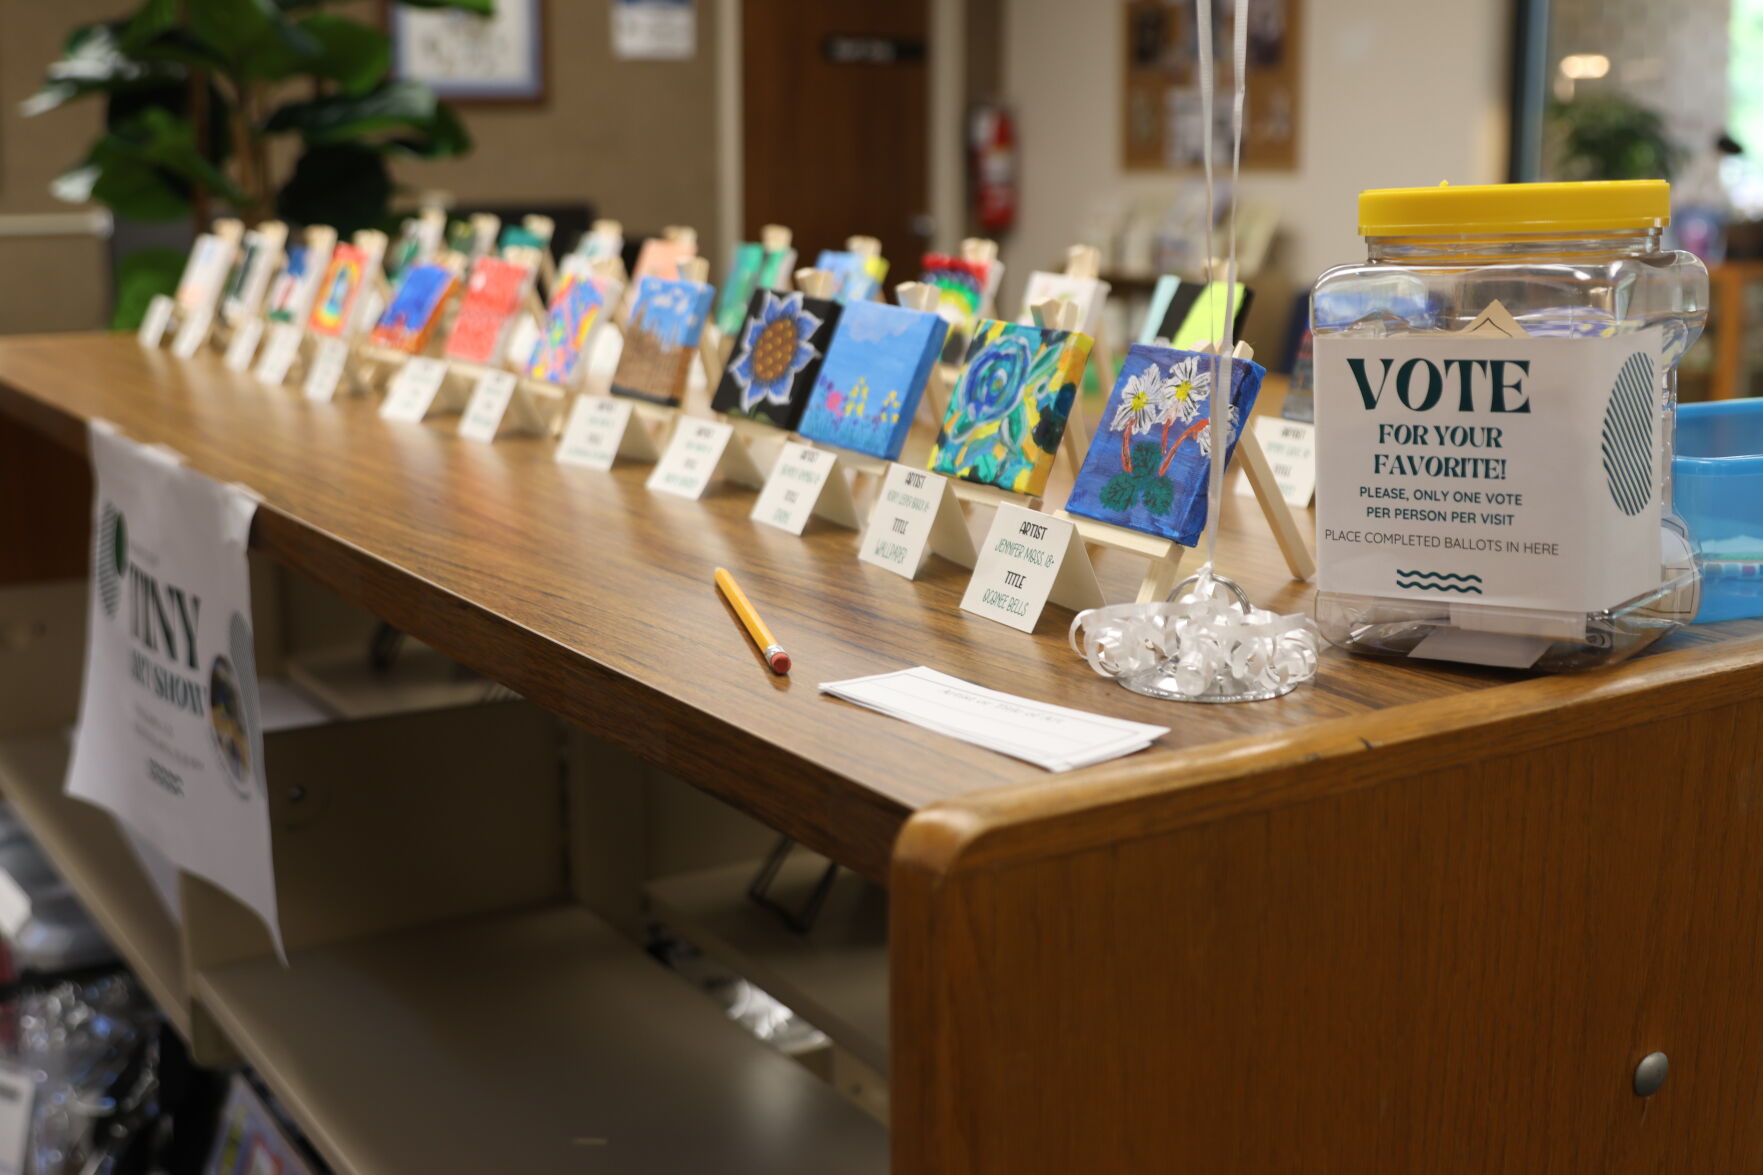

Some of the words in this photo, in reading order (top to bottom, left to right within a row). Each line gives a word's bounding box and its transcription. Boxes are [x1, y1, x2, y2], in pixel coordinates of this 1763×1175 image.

[1346, 357, 1531, 414] VOTE
[1378, 423, 1429, 446] FOR
[1433, 425, 1503, 448] YOUR
[1374, 453, 1507, 480] FAVORITE!
[1359, 486, 1409, 502] PLEASE,
[1413, 488, 1449, 502] ONLY
[1453, 491, 1481, 504] ONE
[1485, 493, 1523, 506] VOTE
[1366, 506, 1391, 519] PER
[1394, 508, 1447, 522] PERSON
[1451, 511, 1477, 524] PER
[1480, 513, 1515, 526] VISIT
[1019, 521, 1048, 540] ARTIST
[1325, 528, 1361, 543] PLACE
[1364, 531, 1441, 549] COMPLETED
[1444, 536, 1503, 553] BALLOTS
[1506, 540, 1520, 553] IN
[1523, 542, 1560, 556] HERE
[994, 538, 1025, 559] JENNIFER
[1004, 569, 1027, 590] TITLE
[129, 561, 202, 671] TINY
[1008, 595, 1030, 618] BELLS
